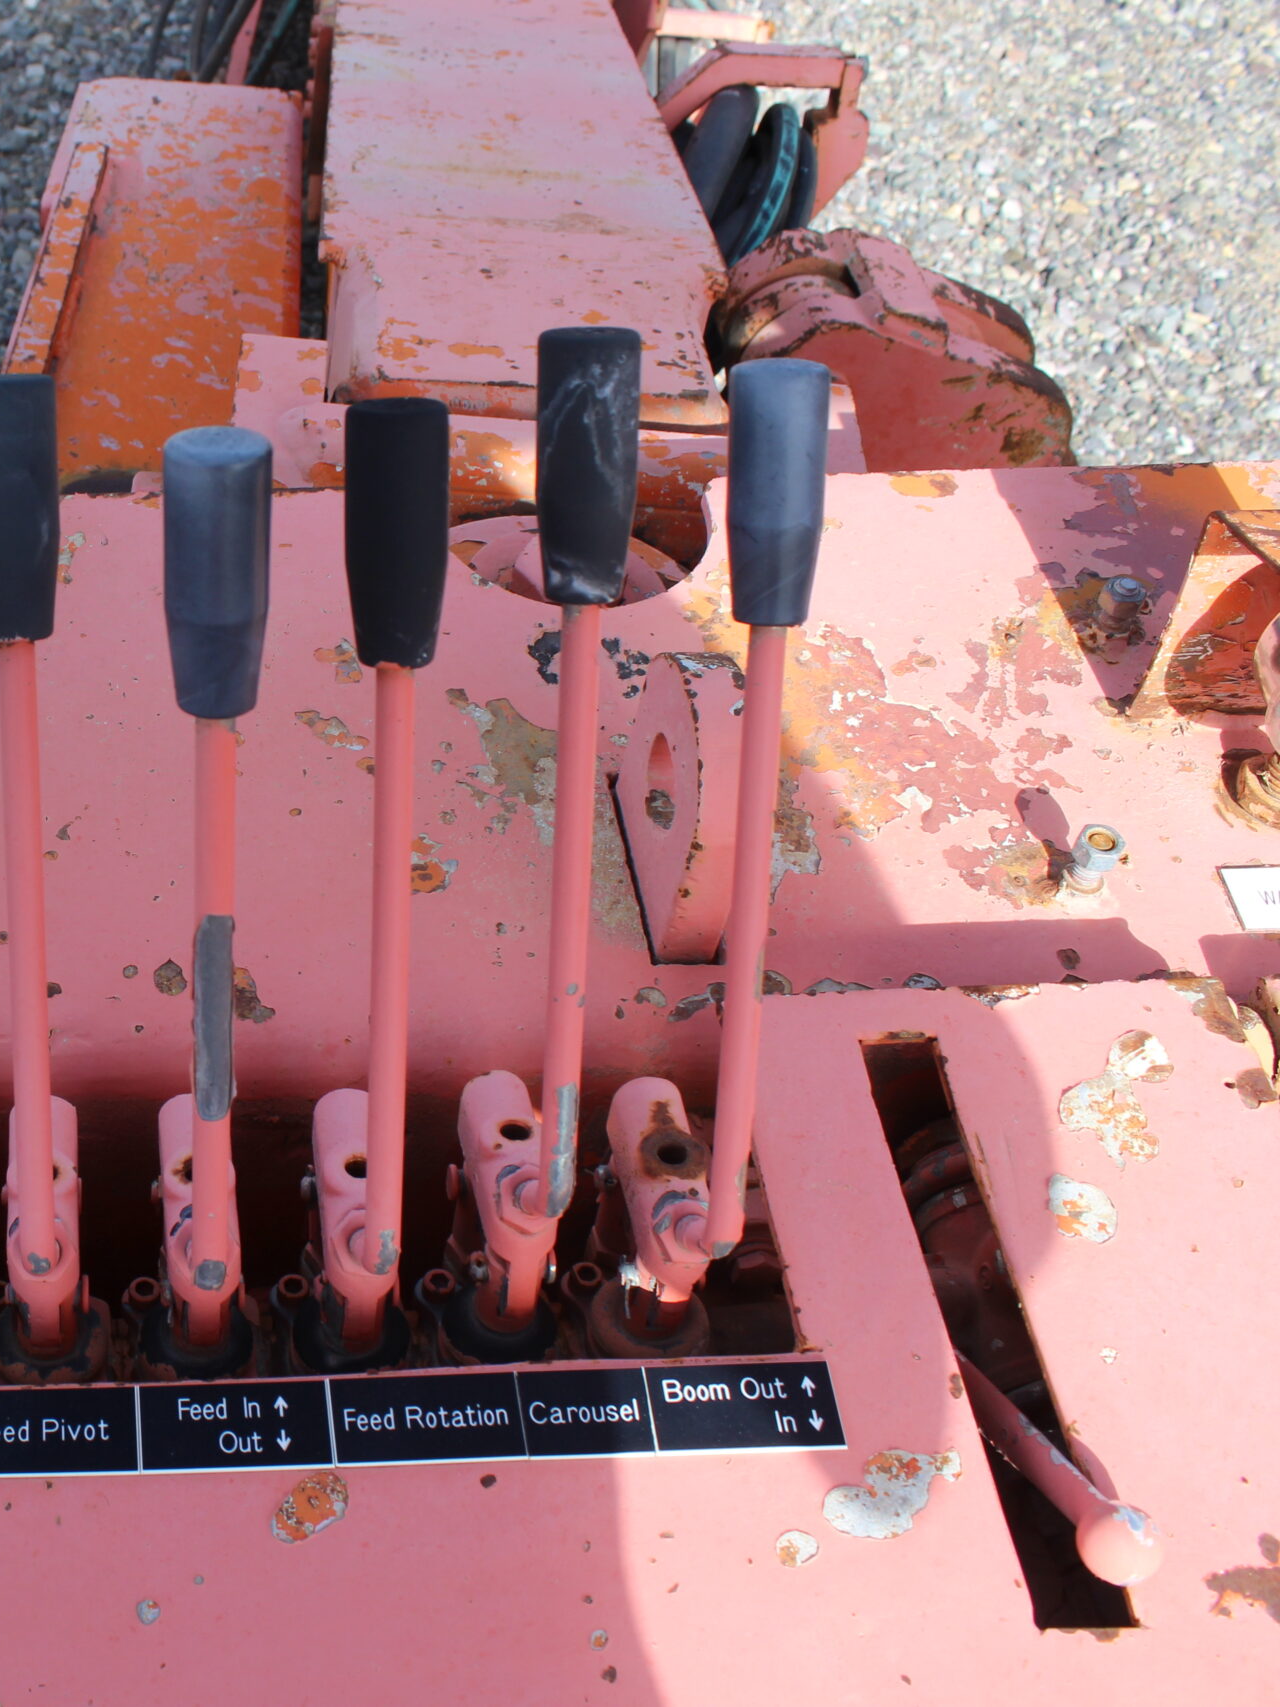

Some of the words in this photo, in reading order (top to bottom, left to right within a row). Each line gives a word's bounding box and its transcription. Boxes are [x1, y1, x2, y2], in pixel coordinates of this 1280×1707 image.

[1257, 889, 1280, 906] W
[661, 1377, 732, 1404] Boom
[739, 1375, 787, 1400] Out
[177, 1396, 228, 1421] Feed
[243, 1396, 261, 1418] In
[343, 1406, 396, 1432] Feed
[405, 1403, 509, 1429] Rotation
[529, 1396, 641, 1425] Carousel
[42, 1417, 109, 1441] Pivot
[774, 1409, 798, 1434] In
[219, 1429, 263, 1454] Out
